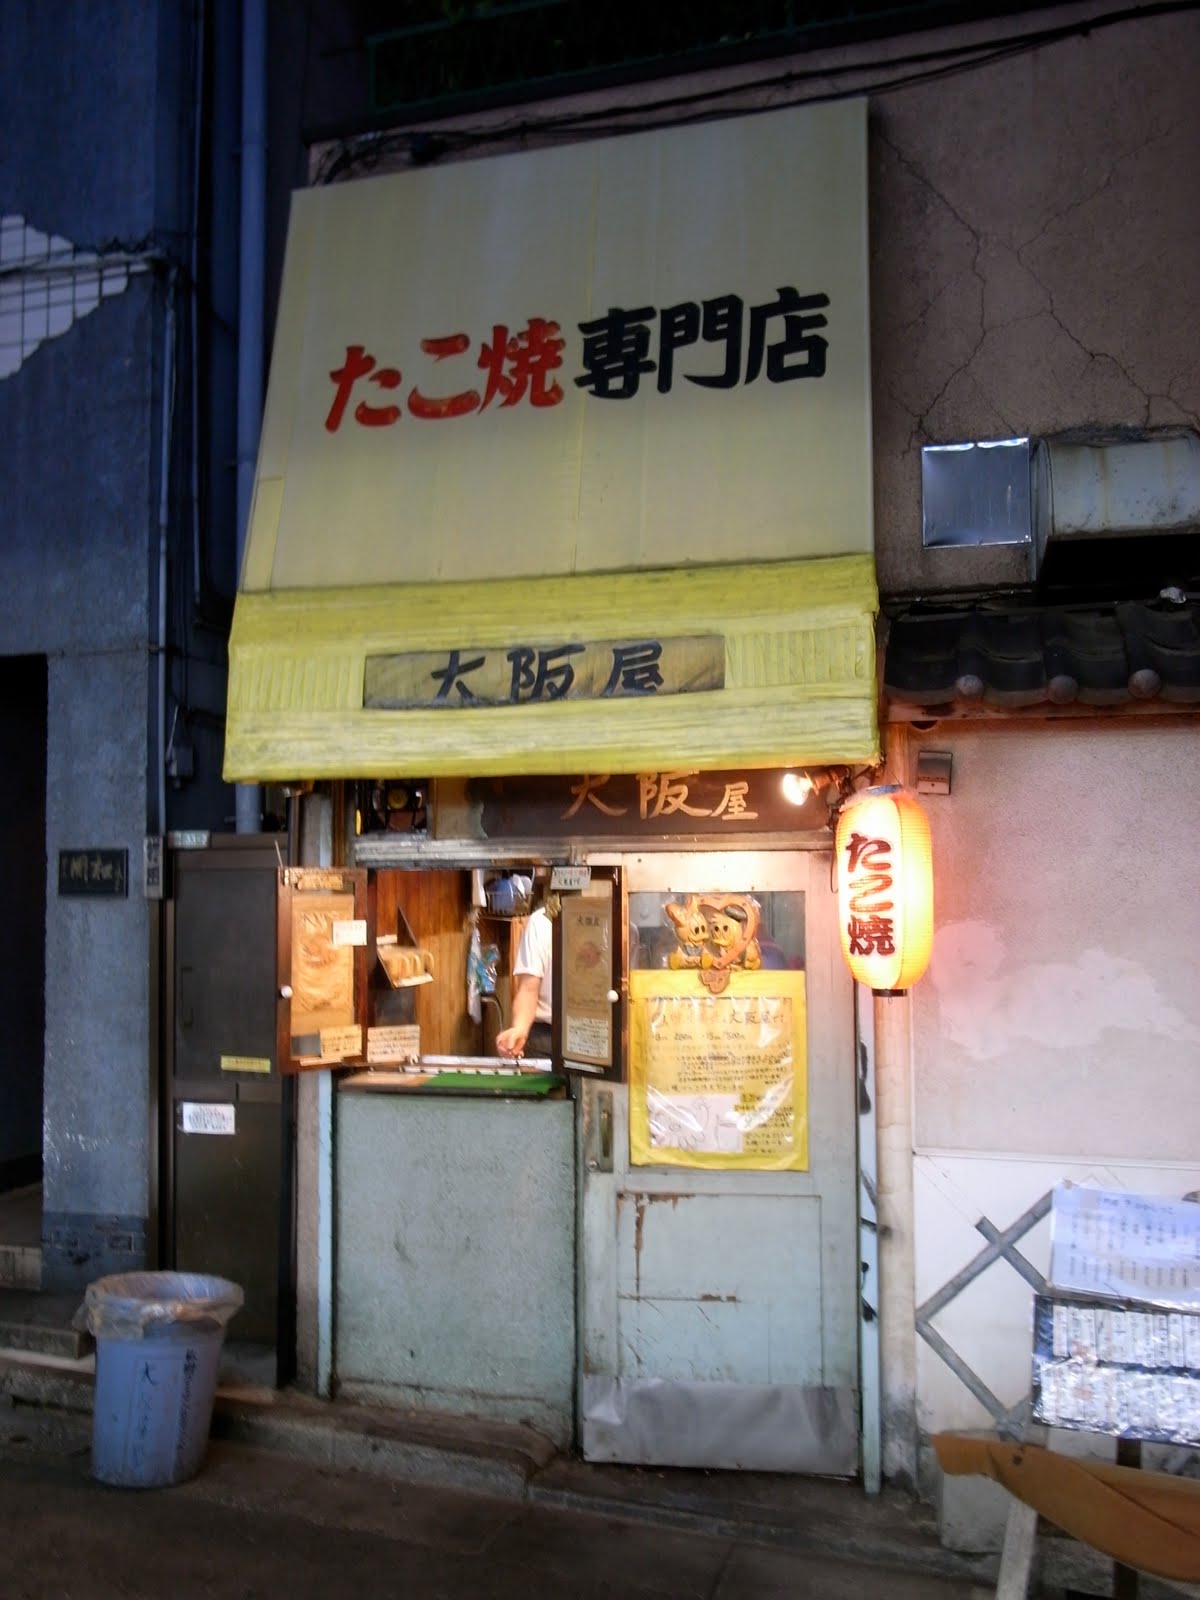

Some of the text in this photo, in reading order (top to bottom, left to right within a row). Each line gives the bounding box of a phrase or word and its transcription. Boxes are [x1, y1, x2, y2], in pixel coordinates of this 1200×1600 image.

[325, 287, 831, 433] たこ焼専門店
[431, 640, 664, 701] 大阪屋
[560, 771, 758, 821] 大阪屋
[845, 833, 896, 957] たこ焼
